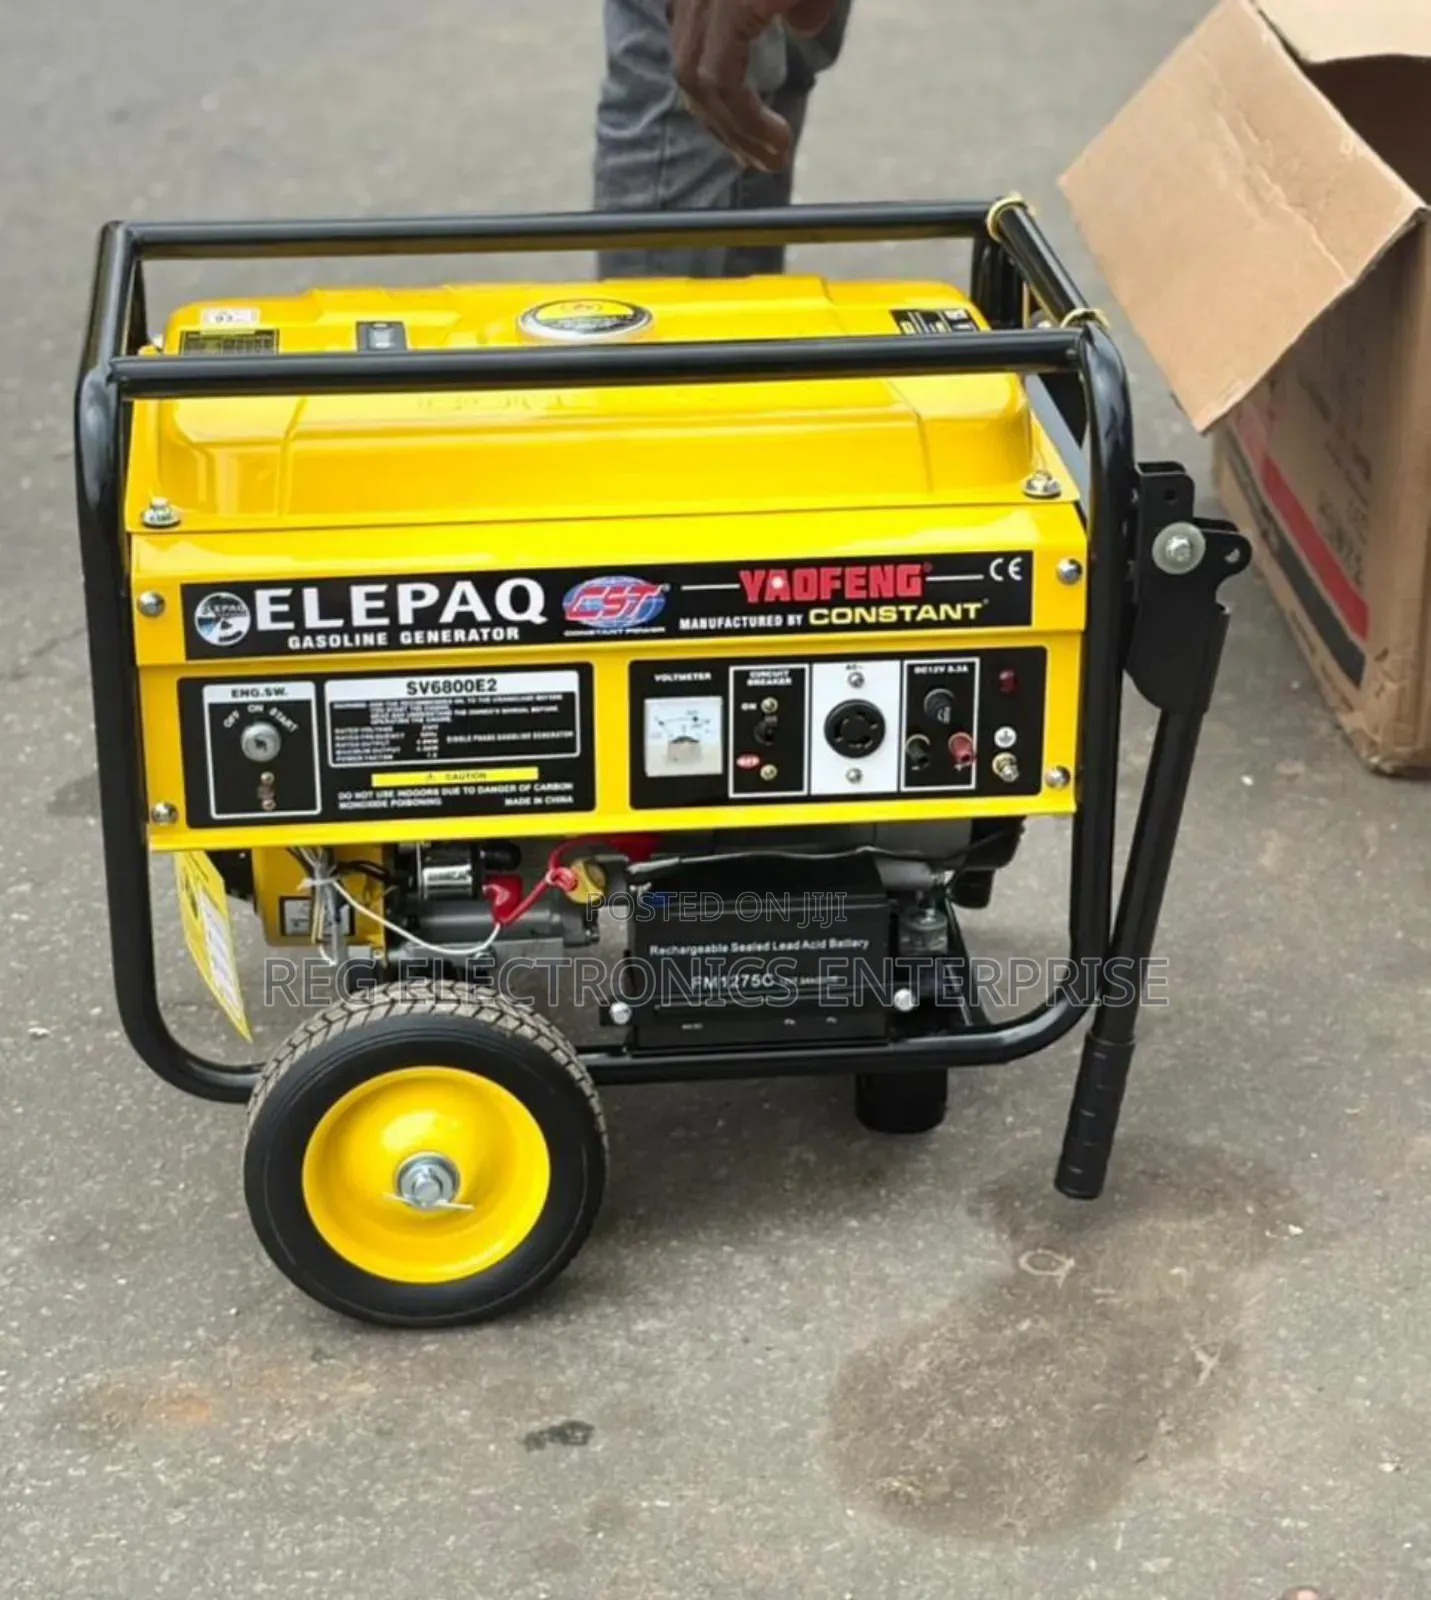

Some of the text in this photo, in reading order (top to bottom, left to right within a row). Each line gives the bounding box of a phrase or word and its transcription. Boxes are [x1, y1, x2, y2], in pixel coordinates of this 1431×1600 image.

[989, 557, 1022, 582] CE
[739, 563, 924, 604] YAOFENG
[255, 577, 548, 631] ELEPAQ
[565, 584, 661, 620] CST
[679, 602, 984, 630] MANUFACTURED BY CONSTANT
[288, 627, 520, 650] GASOLINE GENERATOR
[654, 671, 712, 682] VOLTMETER
[747, 677, 793, 687] BREAKER
[749, 670, 790, 679] CIRCUIT
[406, 678, 498, 696] SV6800E2
[247, 704, 264, 713] ON
[741, 702, 757, 711] ON
[269, 707, 298, 733] START
[444, 771, 487, 781] CAUTION
[338, 782, 574, 801] DO NOT USE INDOORS DUE TO DANGER OF CARBON
[505, 795, 574, 806] MADE IN CHINA
[339, 797, 442, 810] MONOXIDE POISONING
[650, 938, 869, 957] Rechargeable Sealed Lead Acid Battery
